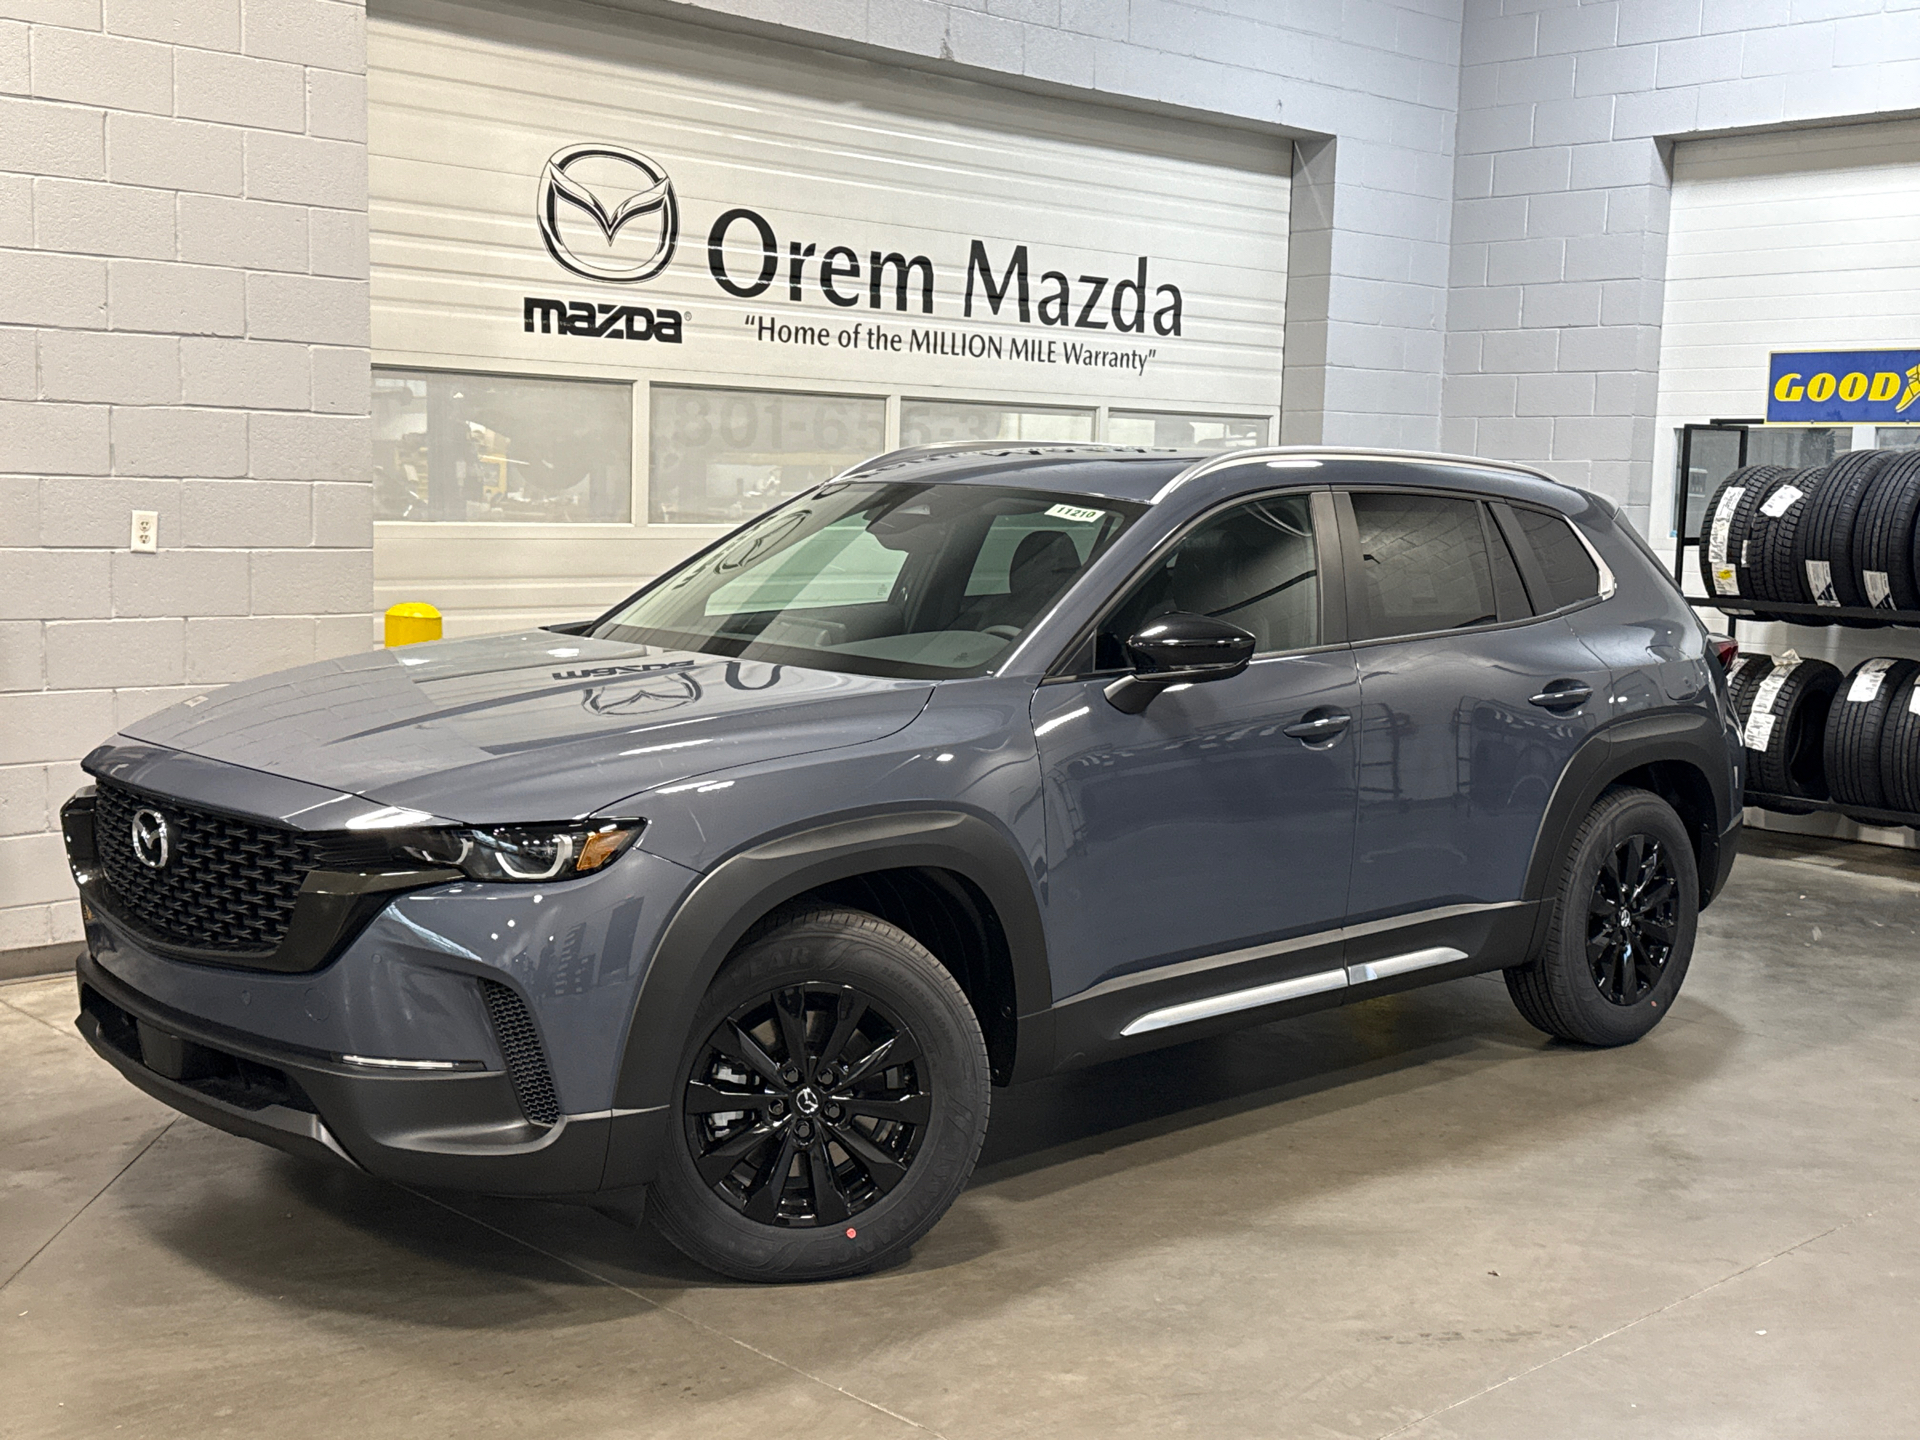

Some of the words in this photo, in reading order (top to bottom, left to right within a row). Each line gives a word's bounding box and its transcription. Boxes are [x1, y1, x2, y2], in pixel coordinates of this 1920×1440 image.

[708, 208, 935, 314] Orem
[964, 239, 1182, 336] Mazda
[838, 323, 862, 348] of
[867, 325, 902, 351] the
[910, 329, 1002, 359] MILLION
[1009, 338, 1057, 363] MILE
[1057, 506, 1096, 518] 11210
